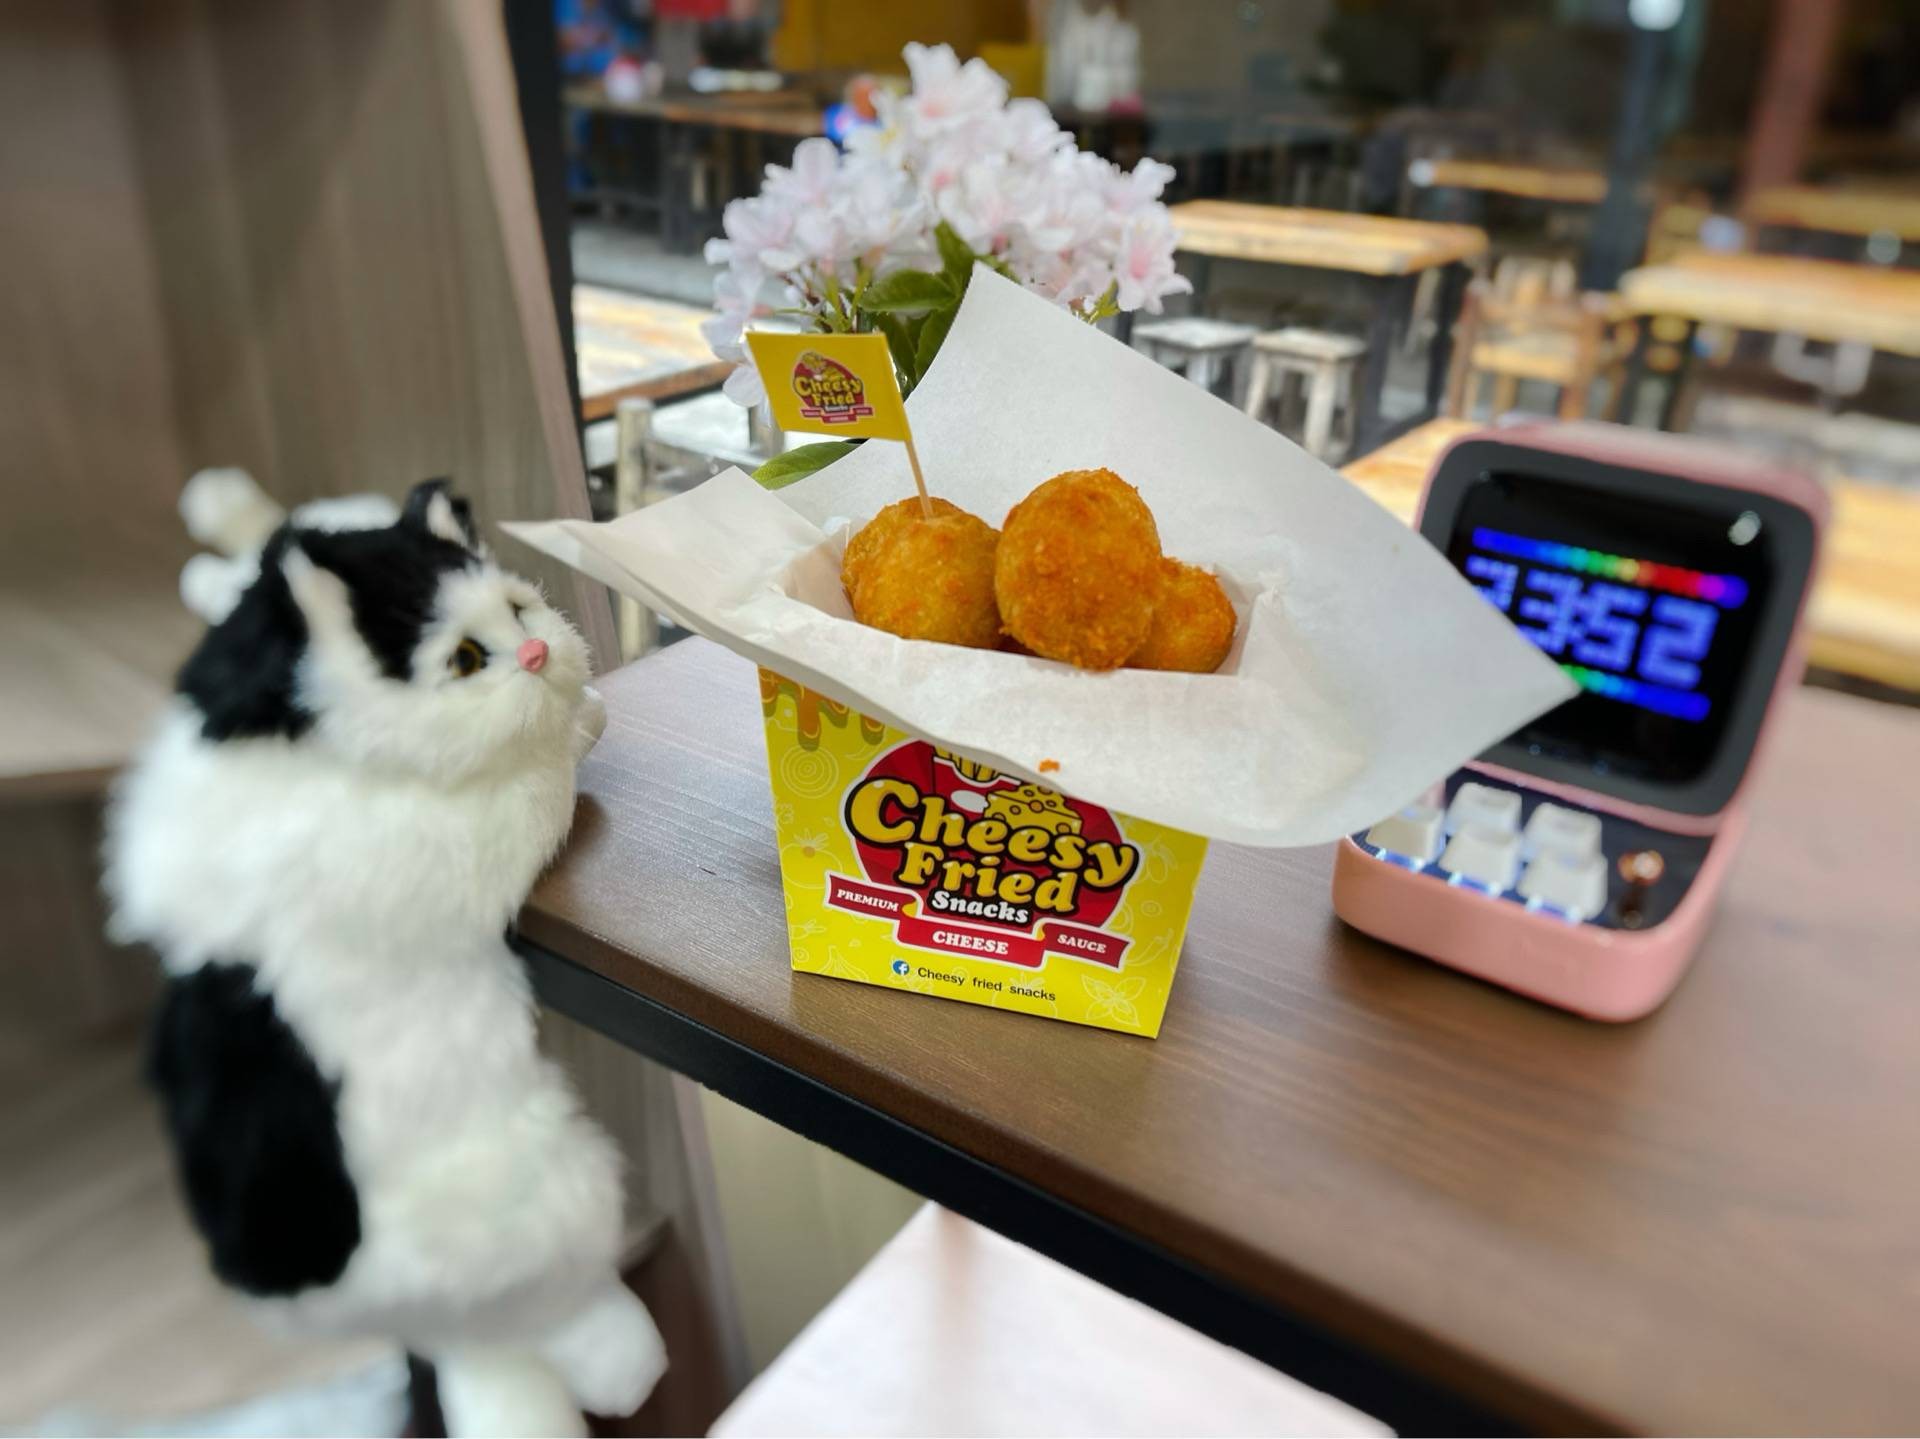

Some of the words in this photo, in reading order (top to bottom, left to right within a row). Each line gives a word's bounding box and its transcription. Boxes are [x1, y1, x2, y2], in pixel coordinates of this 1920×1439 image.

[794, 376, 863, 396] Cheesy
[811, 391, 855, 406] Fried
[847, 777, 1138, 889] Cheesy
[898, 840, 1080, 914] Fried
[836, 888, 900, 912] PREMIUM
[931, 890, 1029, 924] Snacks
[932, 930, 1010, 956] CHEESE
[1057, 933, 1108, 955] SAUCE
[917, 966, 966, 987] Cheesy
[972, 975, 1004, 993] fried
[1009, 985, 1057, 1003] snacks
